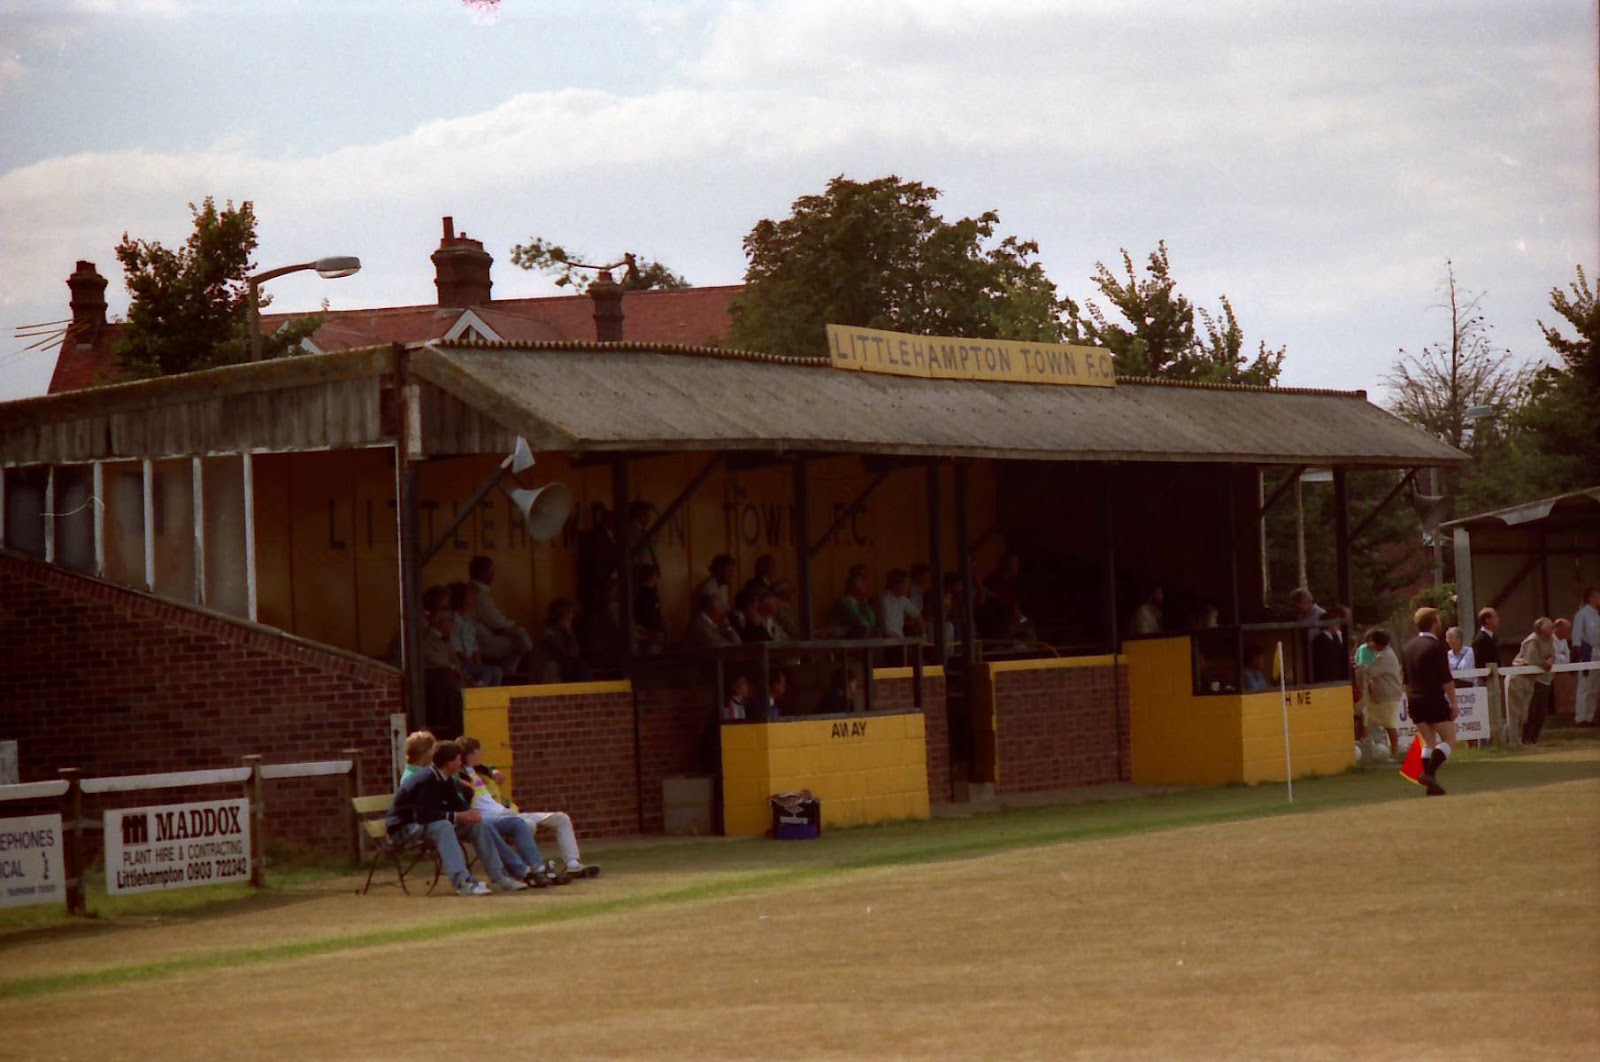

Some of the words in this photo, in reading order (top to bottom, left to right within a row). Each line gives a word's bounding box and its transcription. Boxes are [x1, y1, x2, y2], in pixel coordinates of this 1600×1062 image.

[833, 332, 1011, 373] LITTLEHAMPTON
[1020, 348, 1077, 376] TOWN
[831, 721, 867, 739] AWAY
[155, 806, 242, 841] MADDOX
[122, 849, 152, 866] PLANT
[155, 847, 175, 863] HIRE
[187, 840, 243, 860] CONTRACTING
[116, 866, 184, 889] Littlehampton
[186, 861, 212, 881] 0903
